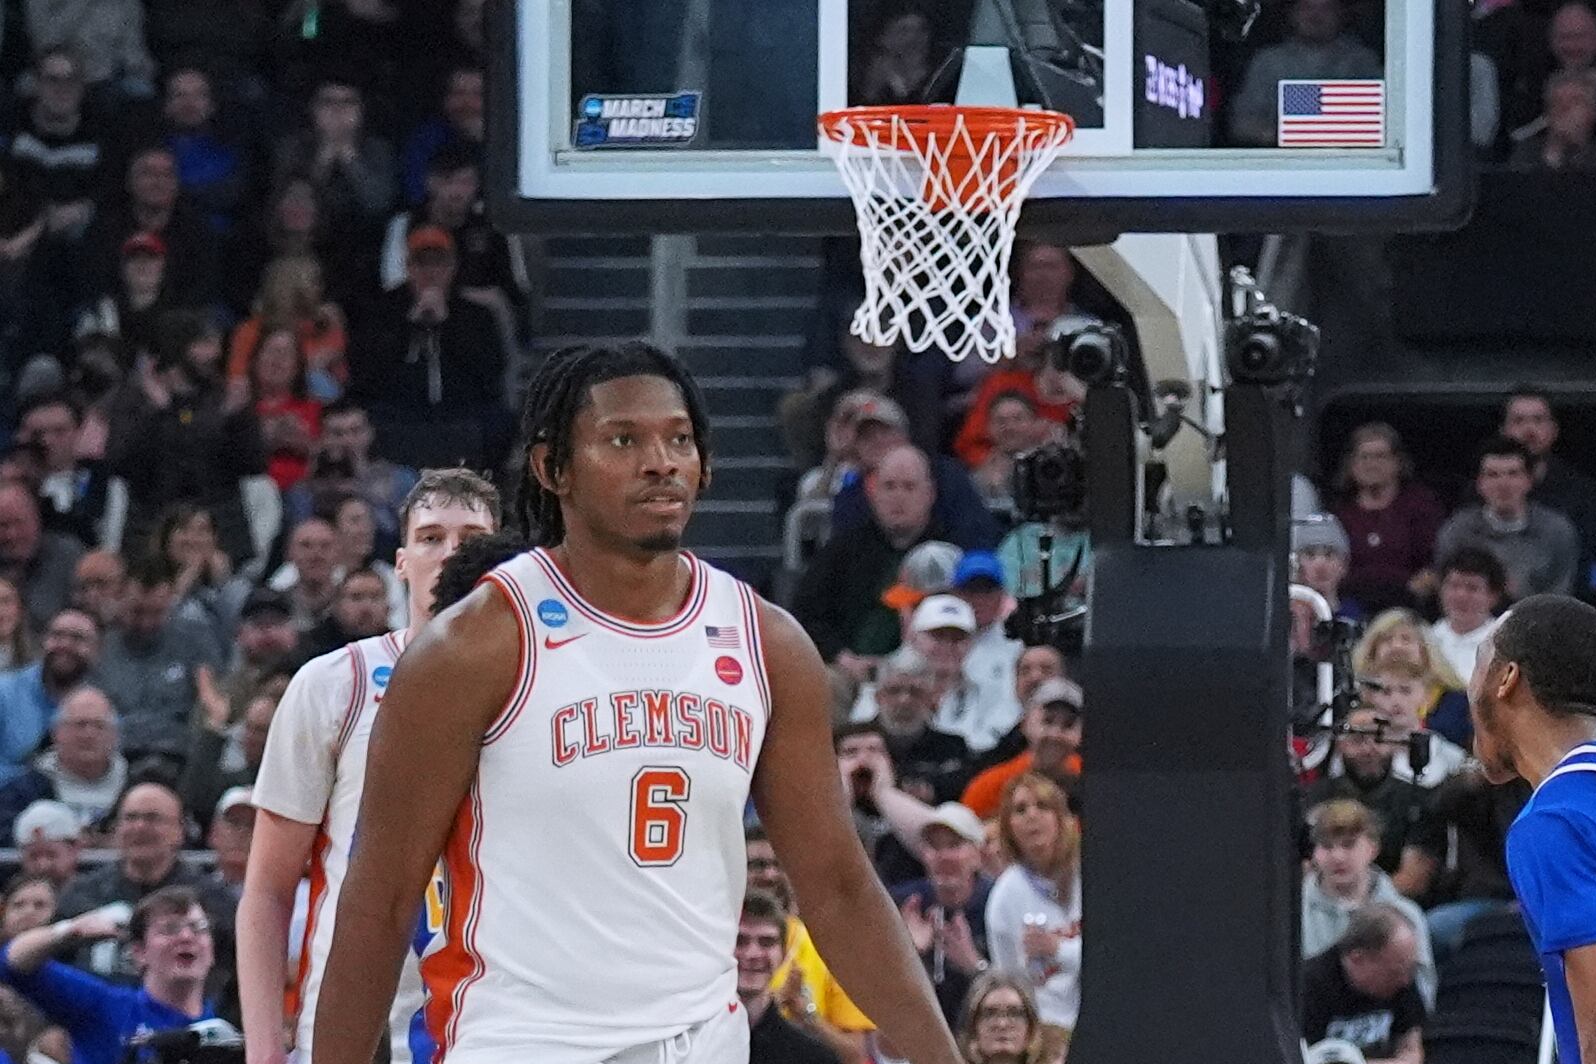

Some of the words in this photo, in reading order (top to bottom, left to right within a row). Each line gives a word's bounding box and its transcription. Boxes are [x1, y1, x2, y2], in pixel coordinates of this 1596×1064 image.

[601, 99, 667, 118] MARCH
[607, 118, 696, 138] MADNESS
[551, 690, 753, 774] CLEMSON
[628, 766, 691, 867] 6
